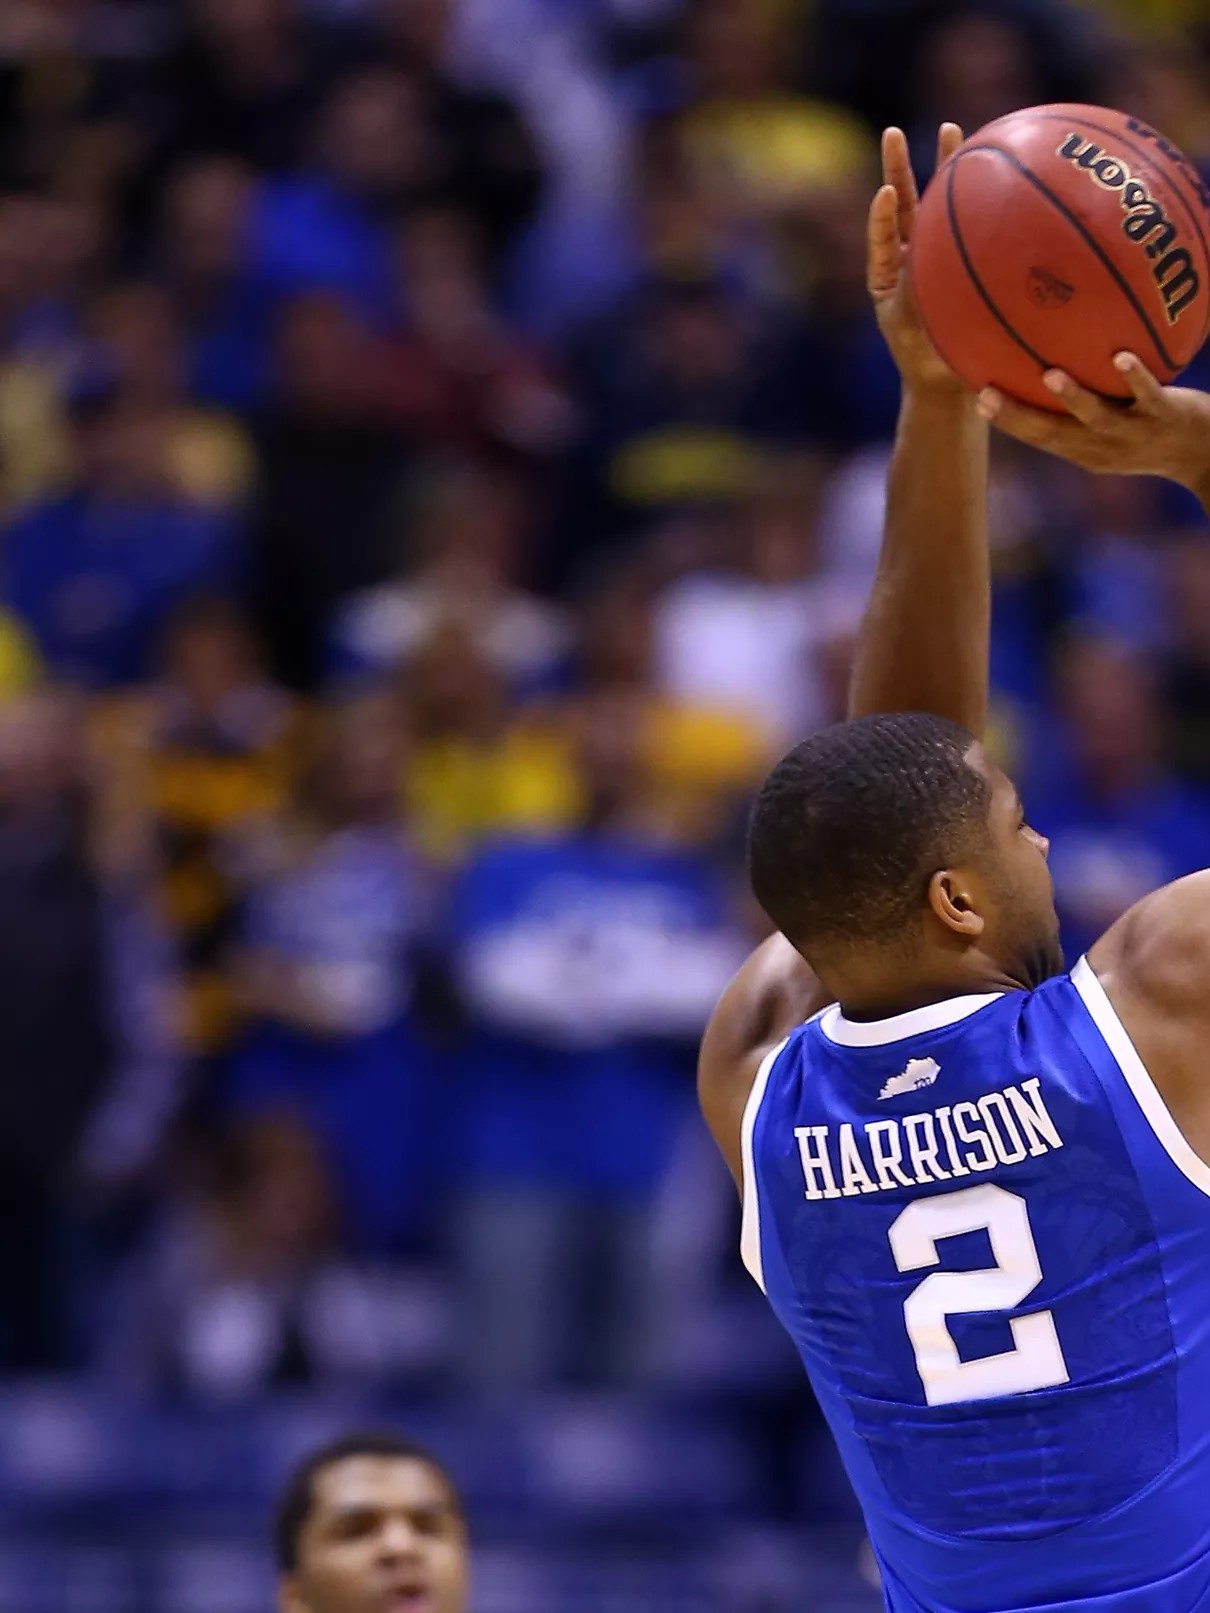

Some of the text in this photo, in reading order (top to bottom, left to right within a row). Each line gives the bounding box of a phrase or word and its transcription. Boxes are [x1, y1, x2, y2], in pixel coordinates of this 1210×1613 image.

[1057, 132, 1200, 326] Wilson
[794, 1077, 1064, 1200] HARRISON
[888, 1182, 1070, 1407] 2
